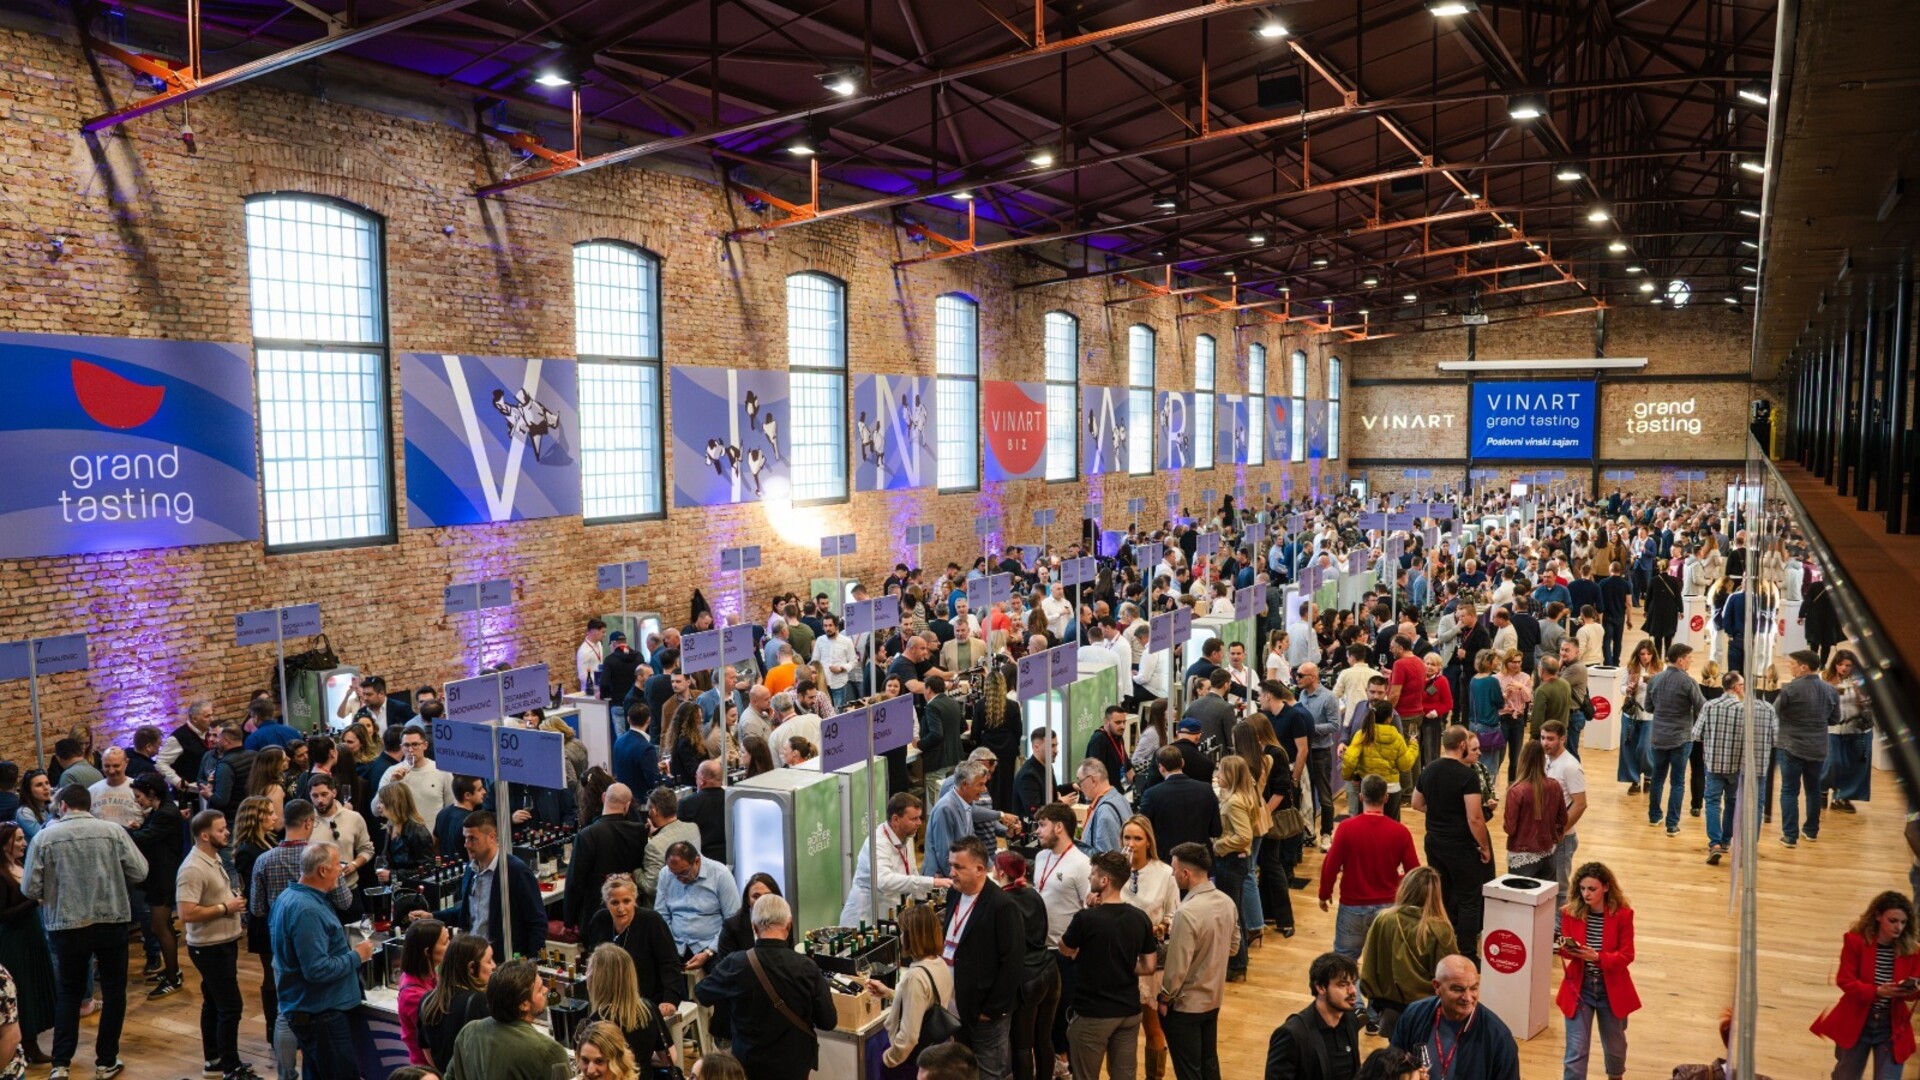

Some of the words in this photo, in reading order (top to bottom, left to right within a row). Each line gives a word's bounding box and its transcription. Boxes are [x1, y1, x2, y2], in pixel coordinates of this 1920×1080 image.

[1487, 393, 1580, 411] VINART
[1634, 397, 1695, 419] grand
[991, 410, 1042, 432] VINART
[1226, 395, 1242, 463] T
[1361, 414, 1455, 430] VINART
[1486, 414, 1526, 429] grand
[1530, 414, 1580, 429] tasting
[1625, 416, 1701, 435] tasting
[442, 355, 543, 521] V
[876, 375, 920, 489] N
[1007, 438, 1027, 451] BIZ
[1486, 437, 1524, 446] Poslovni
[1525, 437, 1551, 446] vinski
[1552, 437, 1579, 448] sajam
[70, 445, 179, 489] grand
[58, 487, 194, 524] tasting
[444, 588, 451, 598] 9
[480, 584, 486, 593] 9
[237, 616, 244, 627] 8
[282, 610, 289, 620] 8
[684, 638, 695, 651] 52
[724, 631, 733, 642] 52
[36, 642, 43, 653] 7
[1051, 650, 1060, 664] 48
[503, 676, 514, 689] 51
[449, 687, 460, 701] 51
[874, 707, 887, 724] 49
[435, 724, 452, 741] 50
[824, 722, 839, 740] 49
[500, 733, 519, 750] 50
